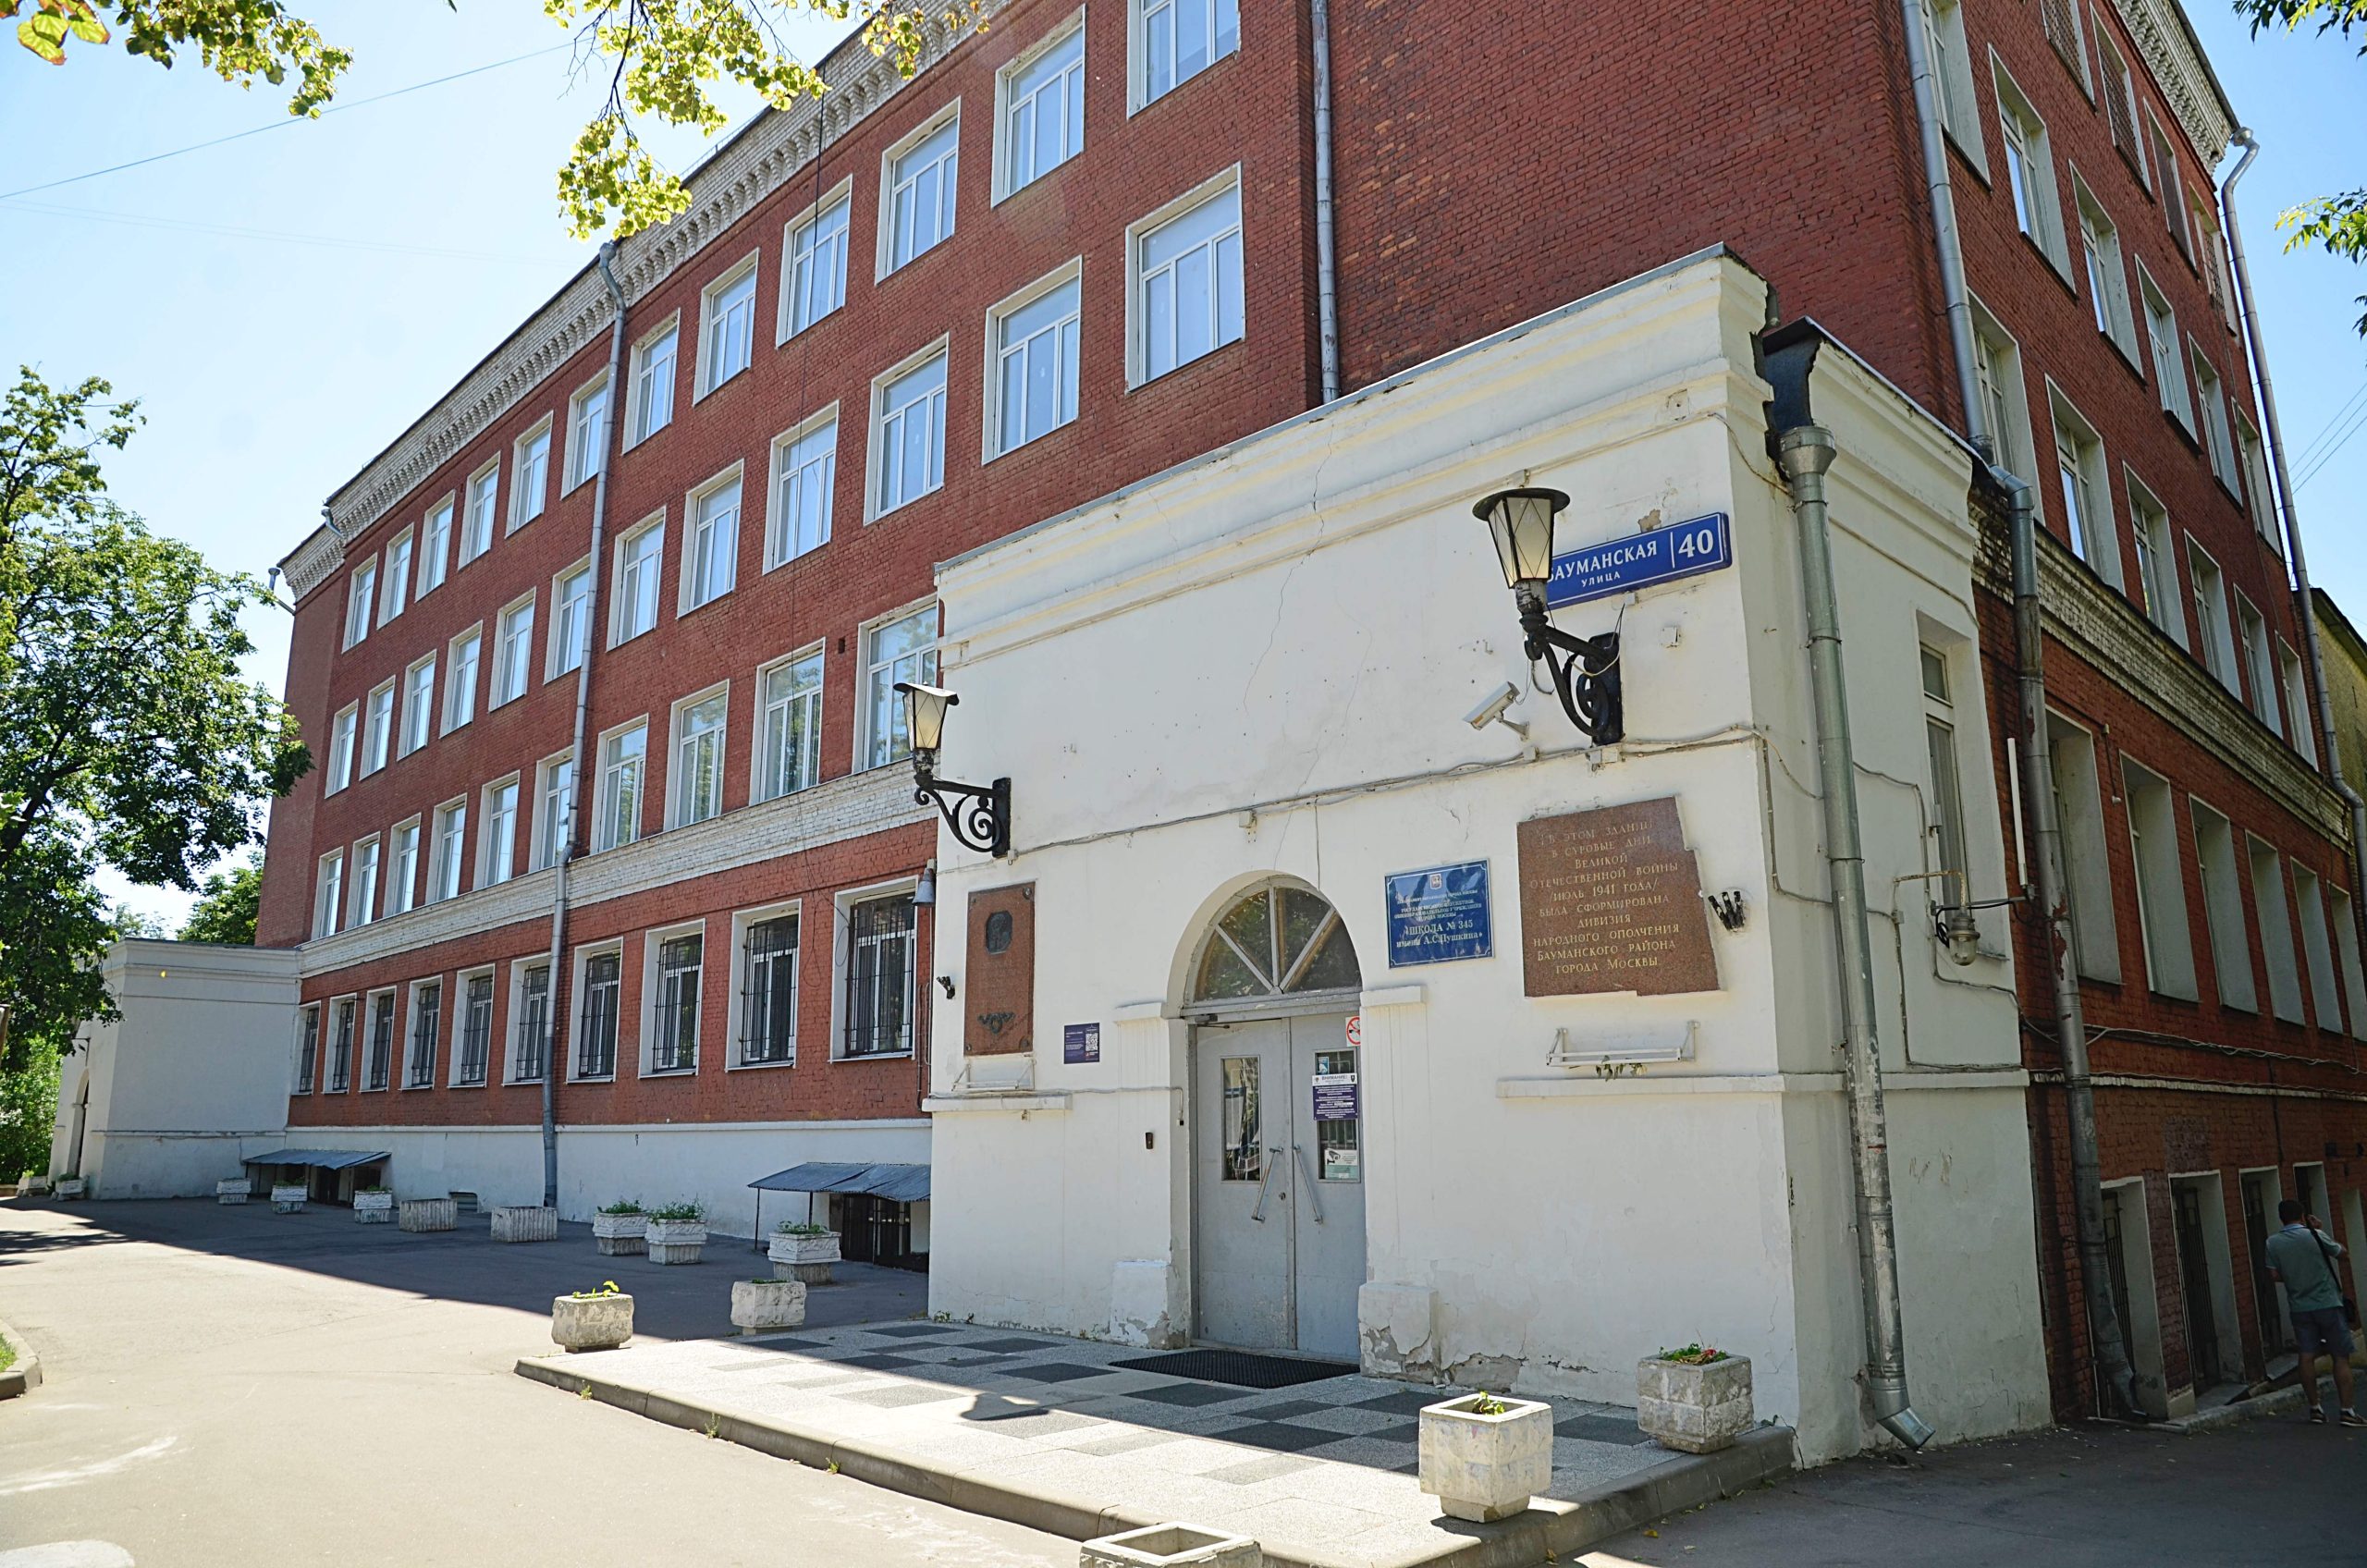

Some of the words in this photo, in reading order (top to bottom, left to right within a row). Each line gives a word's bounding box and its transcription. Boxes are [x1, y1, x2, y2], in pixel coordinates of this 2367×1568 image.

[1678, 529, 1714, 557] 40
[1581, 571, 1621, 588] УЛИЦА
[1564, 829, 1595, 842] ЭТОМ
[1564, 842, 1614, 856] СУРОВЫЕ
[1625, 835, 1651, 848] ДНИ
[1575, 852, 1628, 870] ВЕЛИКОЙ
[1530, 867, 1627, 889] ОТЕЧЕСТВЕННОЙ
[1636, 863, 1678, 876] ВОЙНЫ
[1592, 884, 1615, 897] 1941
[1539, 906, 1568, 918] БЫЛА
[1576, 894, 1670, 913] СФОРМИРОВАНА
[1458, 919, 1473, 929] 345
[1577, 913, 1631, 929] ДИВИЗИЯ
[1533, 933, 1600, 948] НАРОДНОГО
[1609, 924, 1680, 939] ОПОЛЧЕНИЯ
[1538, 945, 1618, 962] БАУМАНСКОГО
[1628, 940, 1676, 952] РАЙОНА
[1556, 962, 1599, 974] ГОРОДА
